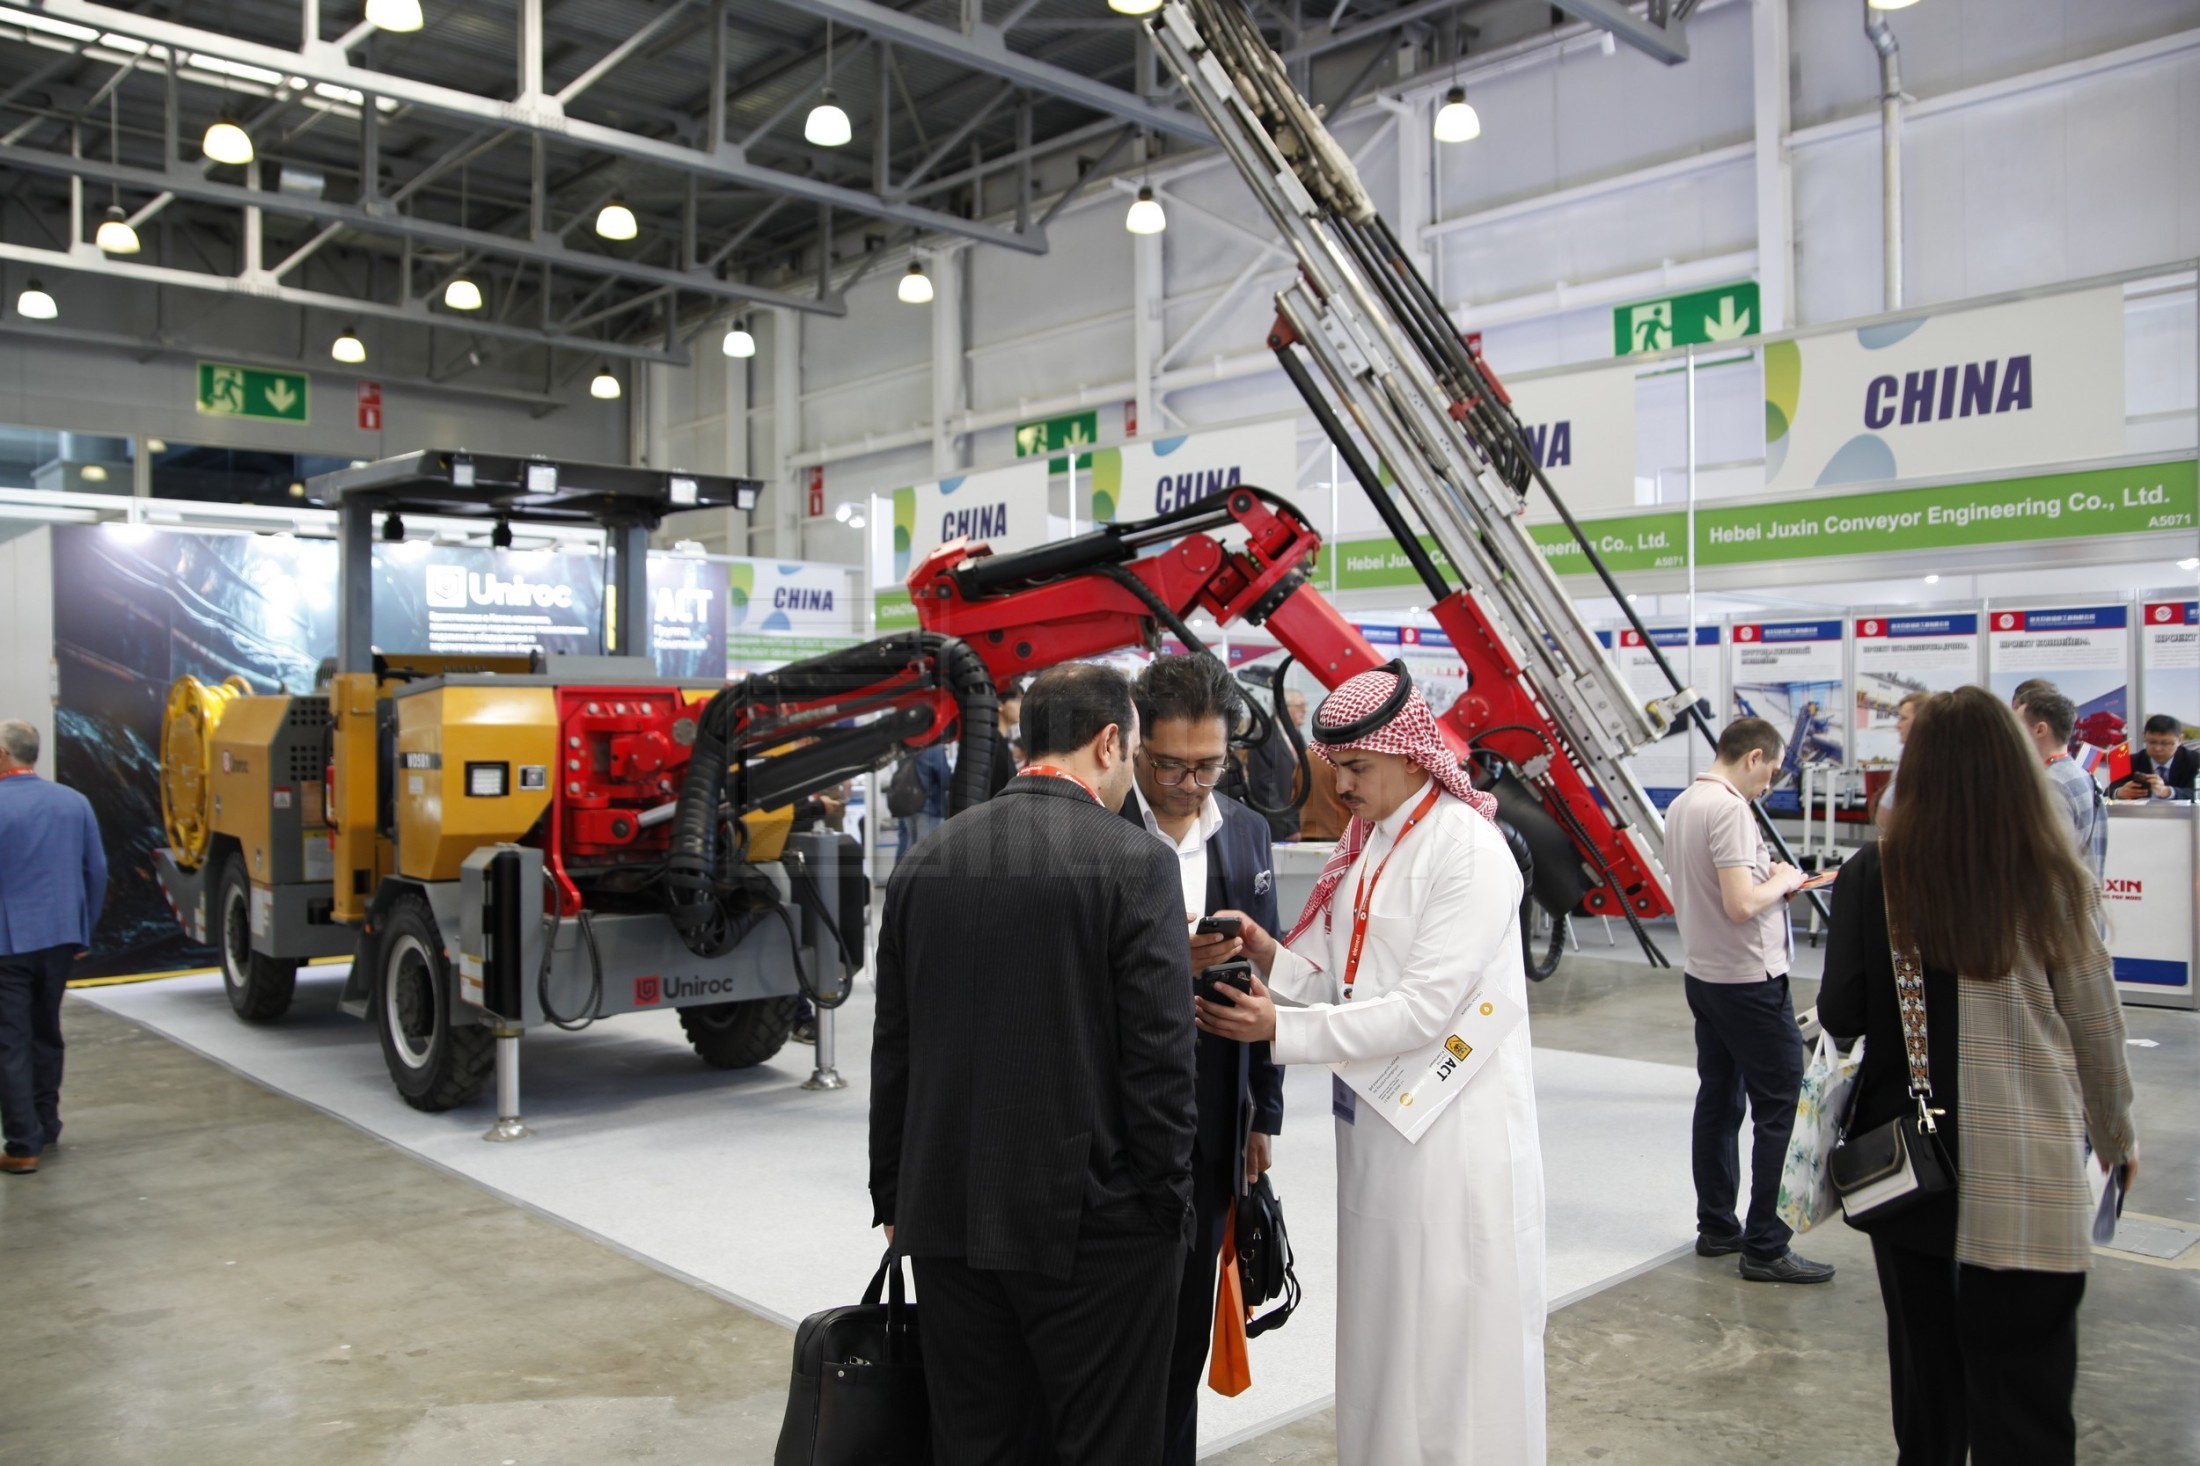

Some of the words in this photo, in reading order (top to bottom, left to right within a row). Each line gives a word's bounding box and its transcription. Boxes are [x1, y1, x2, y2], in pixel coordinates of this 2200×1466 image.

[1863, 354, 2033, 430] CHINA
[942, 502, 1007, 543] CHINA
[1709, 523, 1761, 544] Hebei
[1766, 518, 1819, 540] Juxin
[1824, 509, 1922, 533] Conveyor
[1927, 498, 2061, 527] Engineering
[2068, 492, 2116, 512] Co.,
[2123, 484, 2171, 507] Ltd.
[2148, 512, 2192, 528] A5071
[1601, 535, 1634, 554] Co.,
[1638, 531, 1670, 550] Ltd.
[1346, 554, 1385, 572] Hebei
[1388, 553, 1413, 569] Jux
[1654, 556, 1684, 568] A5071
[468, 572, 573, 609] Uniroc
[773, 586, 834, 612] CHINA
[2102, 879, 2142, 893] XIN
[662, 976, 734, 1000] Uniroc
